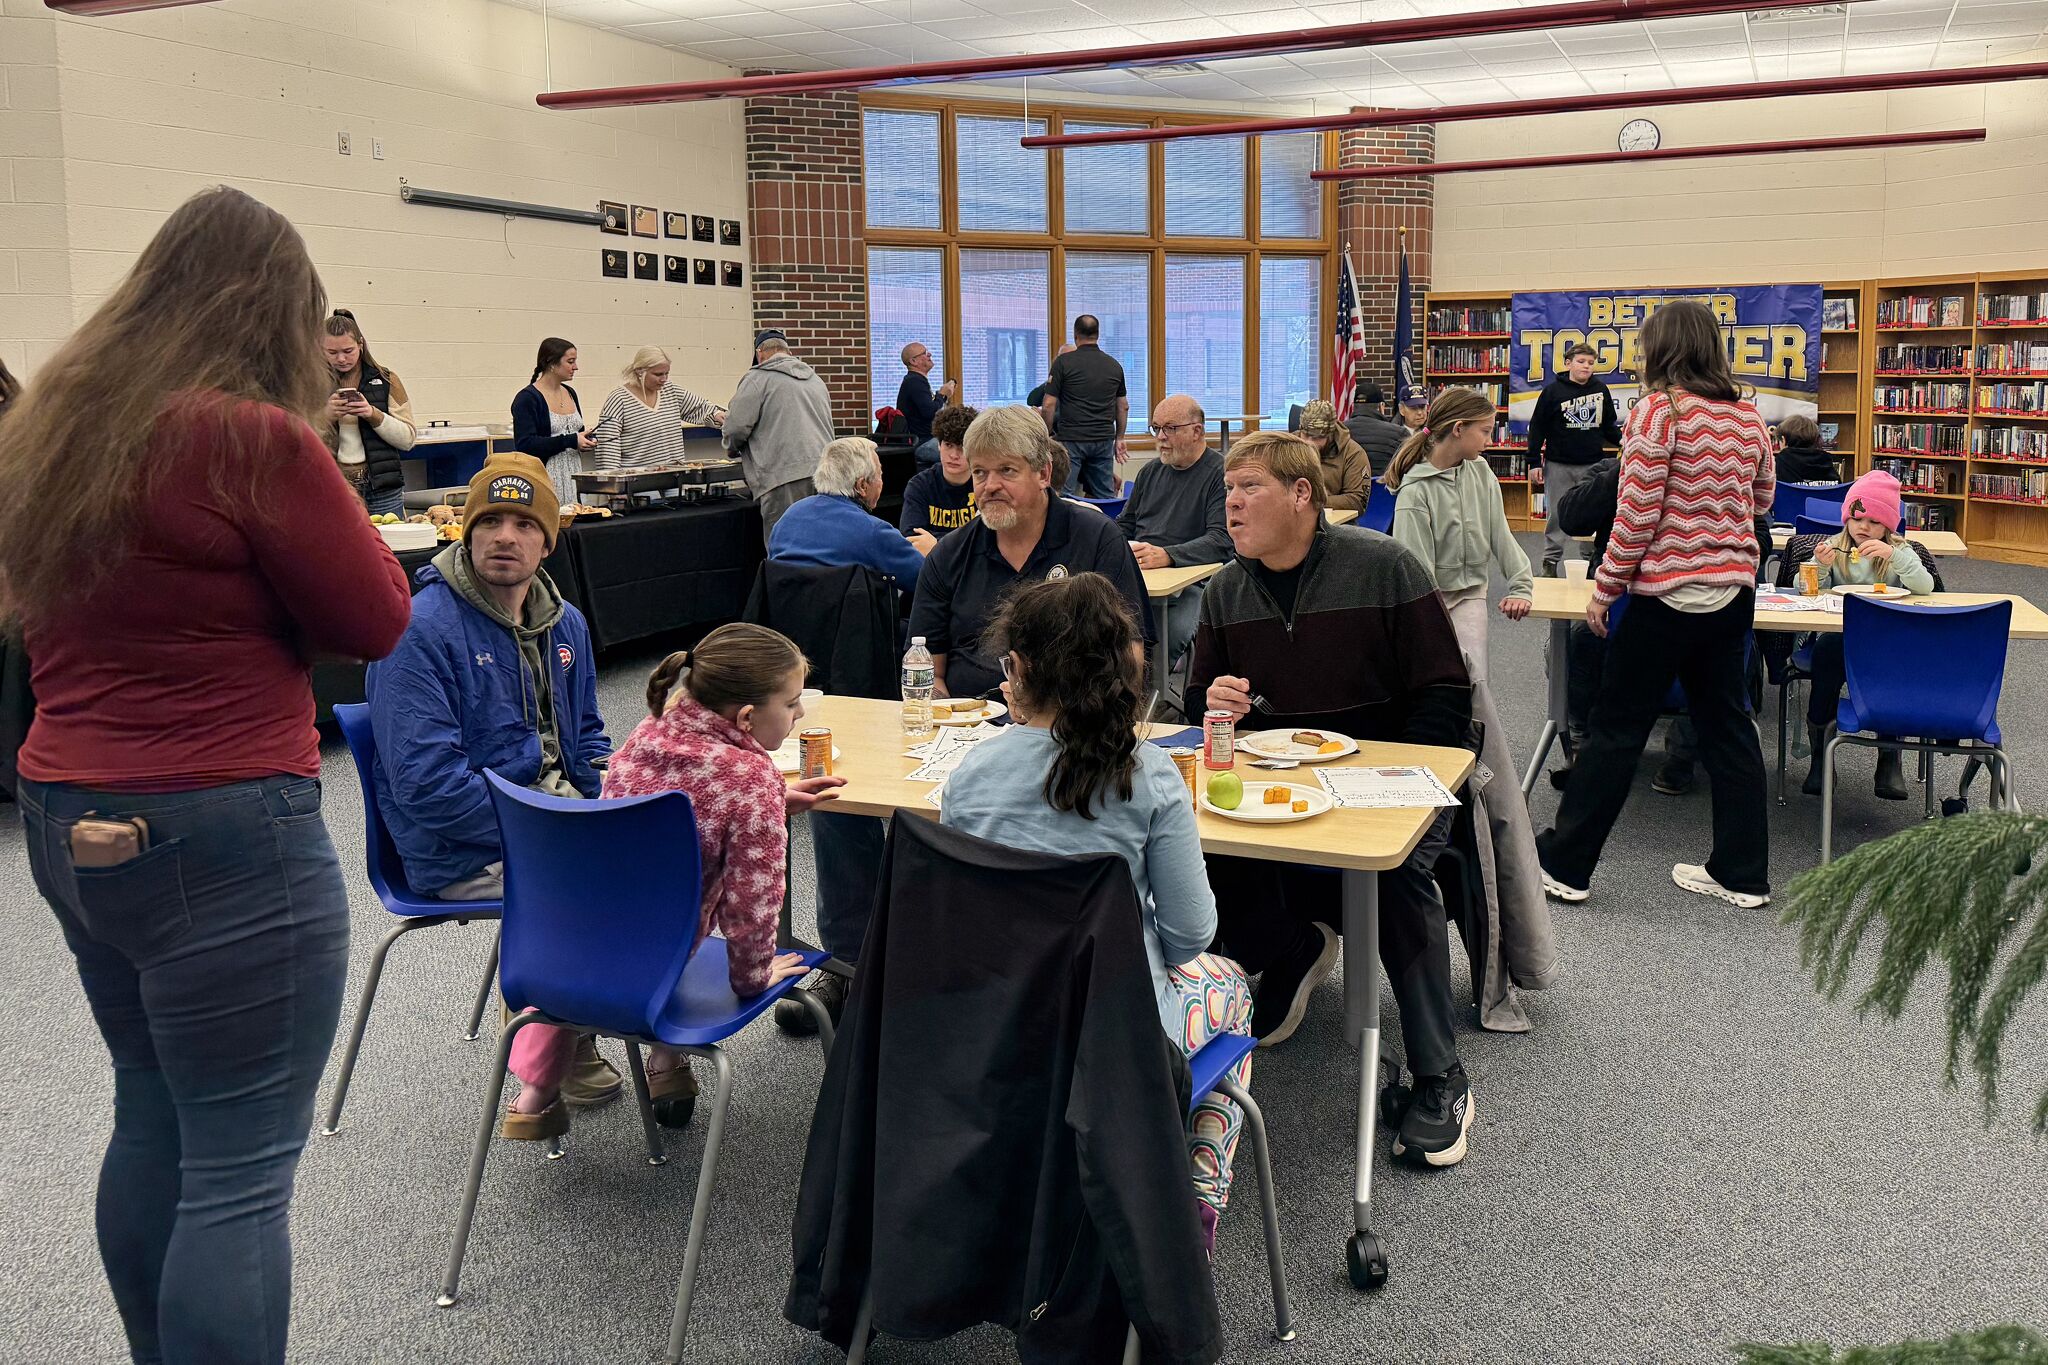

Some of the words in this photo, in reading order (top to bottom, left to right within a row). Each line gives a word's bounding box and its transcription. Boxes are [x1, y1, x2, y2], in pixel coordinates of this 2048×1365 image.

[1588, 294, 1737, 326] BETR
[1520, 324, 1807, 381] TOGEER
[492, 477, 530, 491] CARHARTT
[929, 505, 976, 527] MICHIGA
